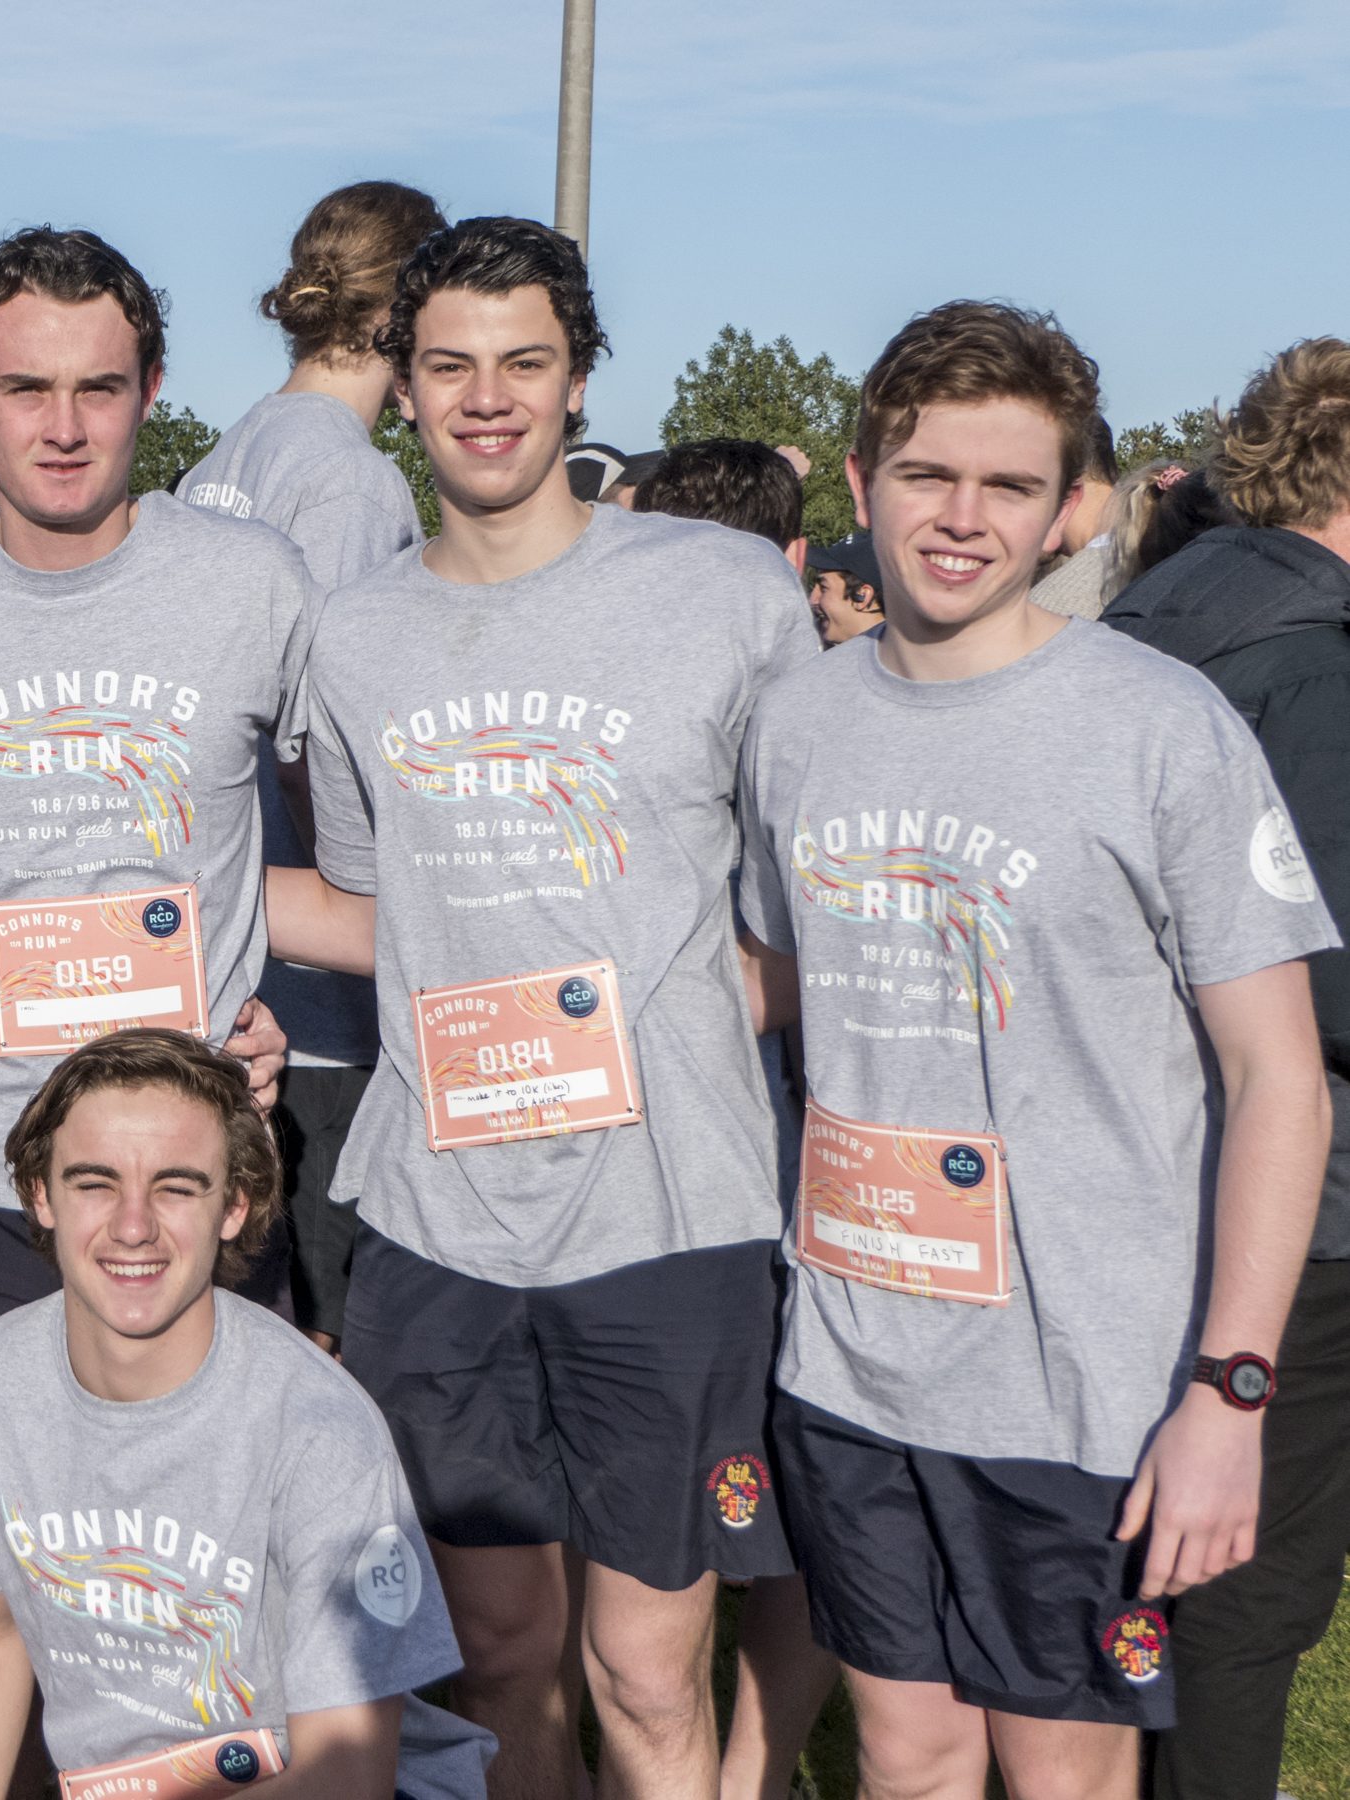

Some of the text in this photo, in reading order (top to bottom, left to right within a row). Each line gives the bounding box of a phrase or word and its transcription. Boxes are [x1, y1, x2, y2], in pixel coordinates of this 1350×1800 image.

[382, 691, 632, 761] CONNOR'S
[29, 735, 125, 775] RUN
[135, 740, 169, 759] 2017
[411, 757, 595, 798] 17/9 RUN 2017
[106, 797, 130, 811] KM
[28, 825, 68, 840] RUN
[76, 817, 113, 848] and
[531, 822, 557, 835] KM
[415, 851, 448, 866] FUN
[453, 851, 493, 865] RUN
[501, 844, 538, 875] and
[793, 809, 1038, 889] CONNOR'S
[14, 856, 154, 880] SUPPORTING BRAIN MATTERS
[446, 886, 583, 909] SUPPORTING BRAIN MATTERS
[863, 880, 949, 926] RUN
[150, 911, 174, 924] RCD
[24, 935, 57, 951] RUN
[55, 954, 133, 988] 0159
[564, 990, 591, 1005] RCD
[806, 972, 941, 1008] FUN RUN and
[424, 997, 499, 1027] CONNOR'S
[83, 1025, 100, 1037] KM
[449, 1020, 478, 1038] RUN
[898, 1025, 931, 1039] BRAIN
[934, 1026, 979, 1046] MATTERS
[477, 1036, 554, 1075] 0184
[808, 1124, 875, 1161] CONNOR'S
[822, 1149, 848, 1170] RUN
[948, 1158, 977, 1172] RCD
[855, 1182, 916, 1215] 1125
[918, 1243, 965, 1265] FAST
[5, 1508, 254, 1594] CONNOR'S
[41, 1578, 231, 1628] 17/9 RUN 2017
[49, 1648, 92, 1665] FUN
[98, 1657, 143, 1673] RUN
[151, 1664, 182, 1688] and
[174, 1645, 199, 1663] KM
[222, 1752, 251, 1771] RCD
